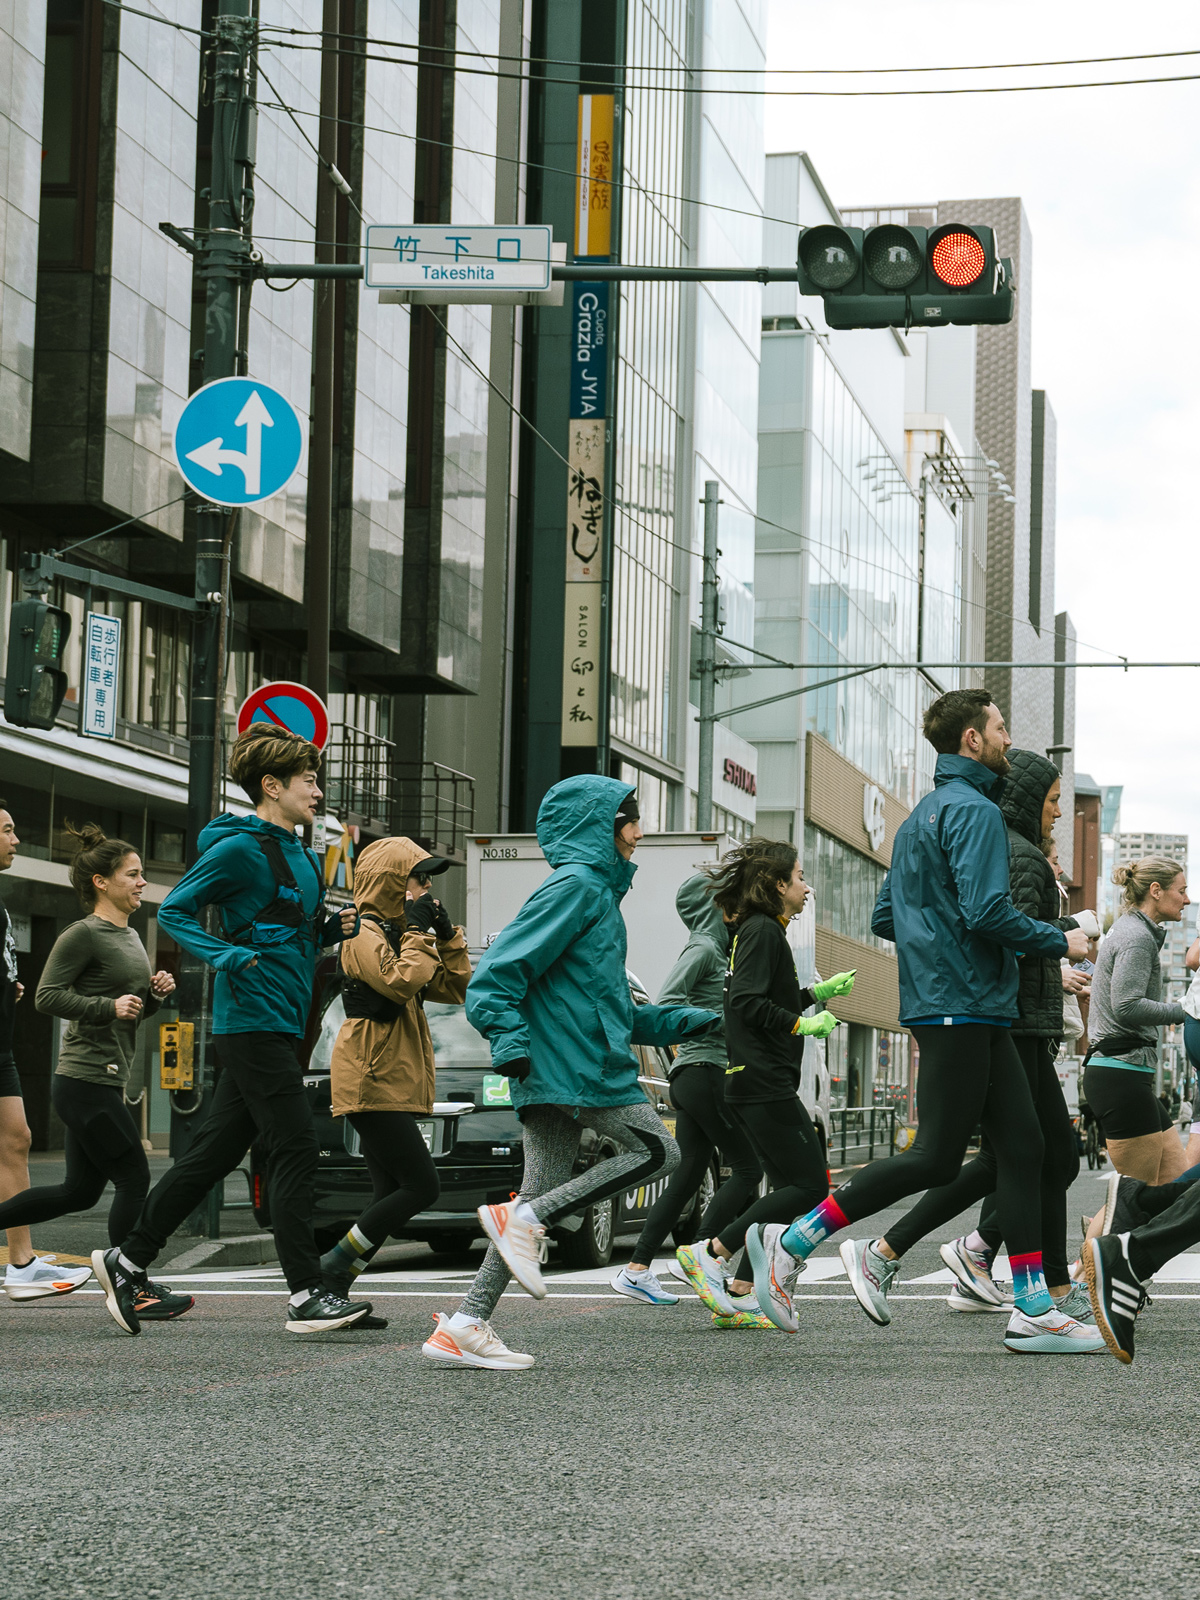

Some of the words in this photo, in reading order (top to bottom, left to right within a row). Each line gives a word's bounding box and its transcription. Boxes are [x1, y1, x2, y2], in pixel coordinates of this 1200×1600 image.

[394, 236, 521, 263] 竹下口
[422, 265, 494, 280] Takeshita
[577, 292, 599, 362] Grazia
[569, 467, 603, 563] ねぎし
[578, 605, 588, 648] SALON
[89, 624, 103, 684] 自転車
[103, 628, 117, 687] 歩行者
[94, 688, 107, 728] 専用
[483, 848, 518, 858] NO.183
[794, 1227, 811, 1247] TOKYO
[1025, 1290, 1049, 1303] TOKYO
